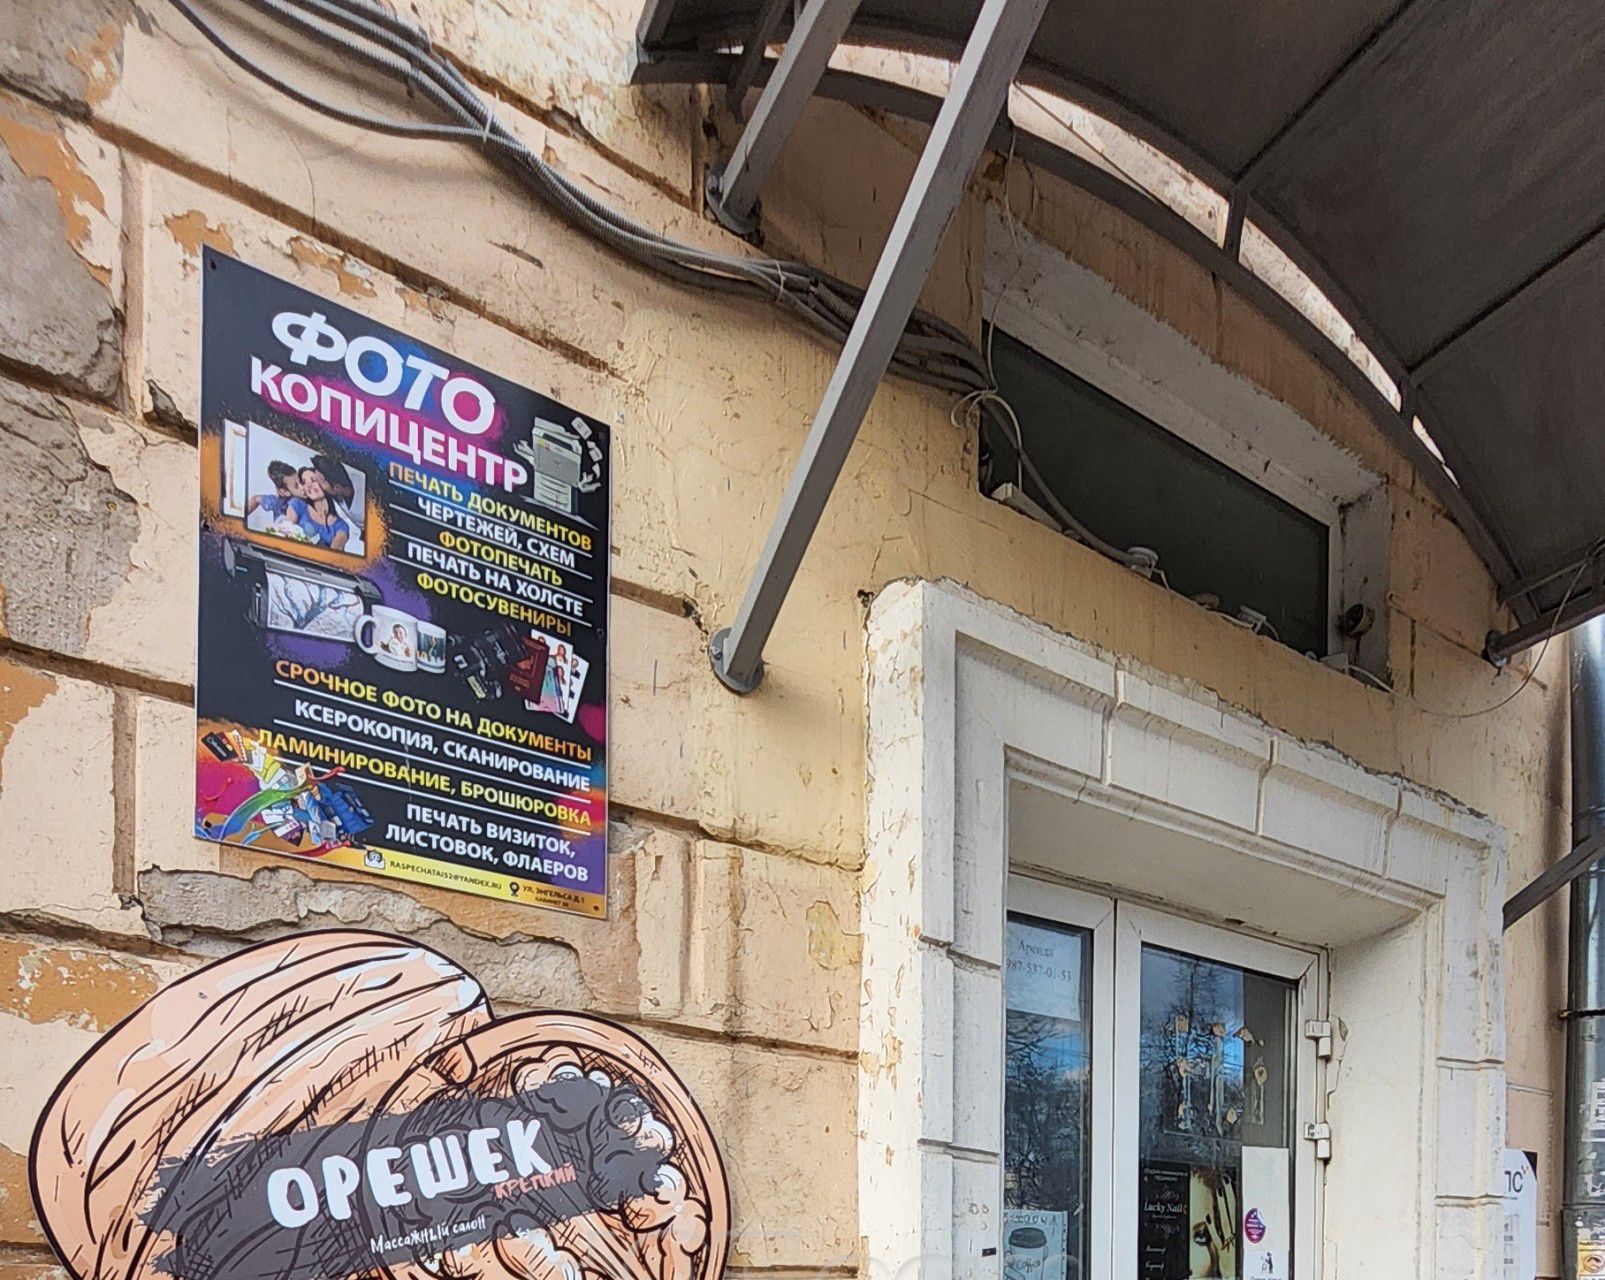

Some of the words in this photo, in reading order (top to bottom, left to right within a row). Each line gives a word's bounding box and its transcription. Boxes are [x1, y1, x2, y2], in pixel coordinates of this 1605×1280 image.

[271, 310, 496, 434] ФОТО
[250, 354, 528, 494] КОПИЦЕНТР
[389, 461, 463, 501] ПЕЧАТЬ
[468, 492, 592, 550] ДОКУМЕНТОВ
[417, 497, 522, 550] ЧЕРТЕЖЕЙ,
[527, 538, 575, 568] СХЕМ
[408, 542, 480, 580] ПЕЧАТЬ
[485, 569, 511, 591] НА
[516, 583, 583, 617] ХОЛСТЕ
[439, 531, 562, 586] ФОТОПЕЧАТЬ
[417, 572, 571, 636] ФОТОСУВЕНИРЫ
[275, 659, 377, 702] СРОЧНОЕ
[383, 689, 440, 720] ФОТО
[446, 708, 472, 729] НА
[477, 718, 592, 762] ДОКУМЕНТЫ
[295, 699, 438, 754] КСЕРОКОПИЯ,
[443, 740, 591, 792] СКАНИРОВАНИЕ
[258, 729, 456, 795] ЛАМИНИРОВАНИЕ,
[461, 780, 592, 826] БРОШЮРОВКА
[385, 823, 498, 865] ЛИСТОВОК,
[503, 848, 589, 882] ФЛАЕРОВ
[407, 803, 482, 835] ПЕЧАТЬ
[487, 825, 576, 859] ВИЗИТОК,
[536, 888, 572, 900] ЭНГЕЛЬСА
[267, 1119, 552, 1228] ОРЕШЕК
[493, 1162, 577, 1199] КРЕПКИЙ
[452, 1213, 486, 1238] салон
